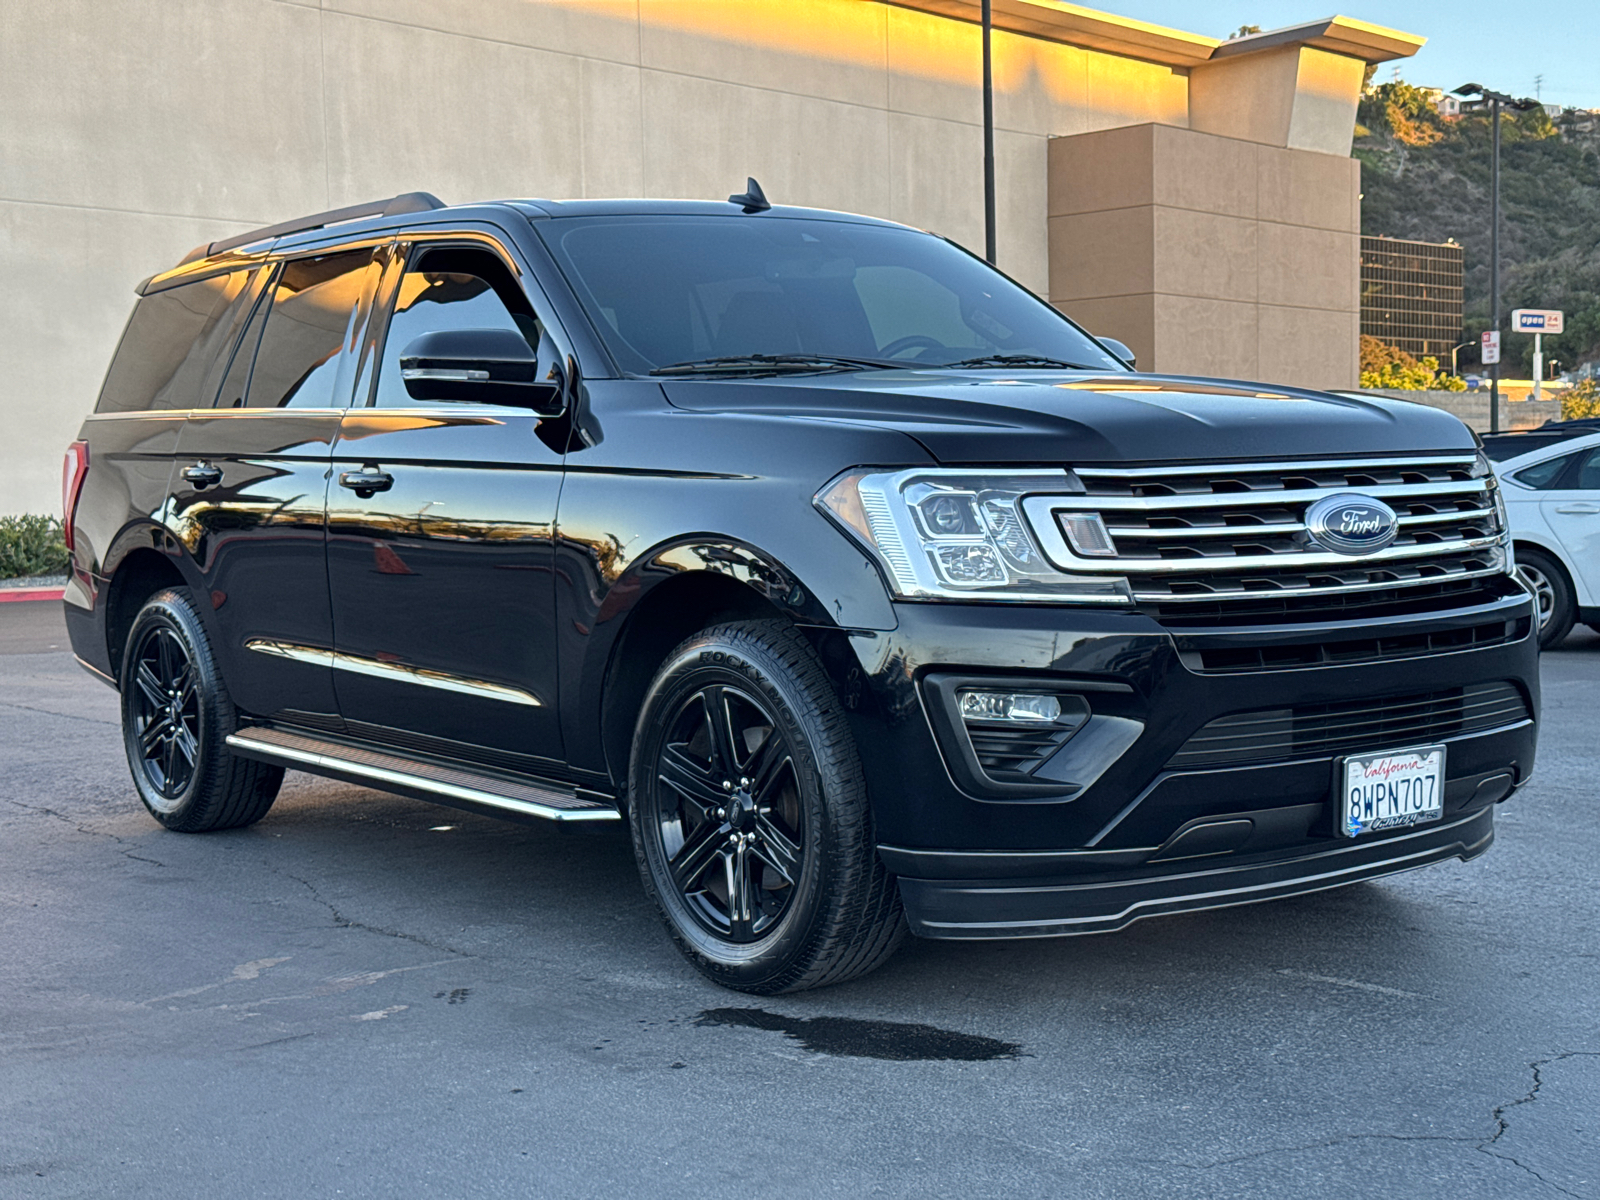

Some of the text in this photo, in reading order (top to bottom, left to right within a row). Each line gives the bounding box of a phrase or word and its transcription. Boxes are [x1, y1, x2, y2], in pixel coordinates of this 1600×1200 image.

[1340, 509, 1380, 535] Ford
[699, 650, 769, 685] ROCKY
[1364, 758, 1425, 780] California
[1350, 774, 1436, 821] 8WPN707
